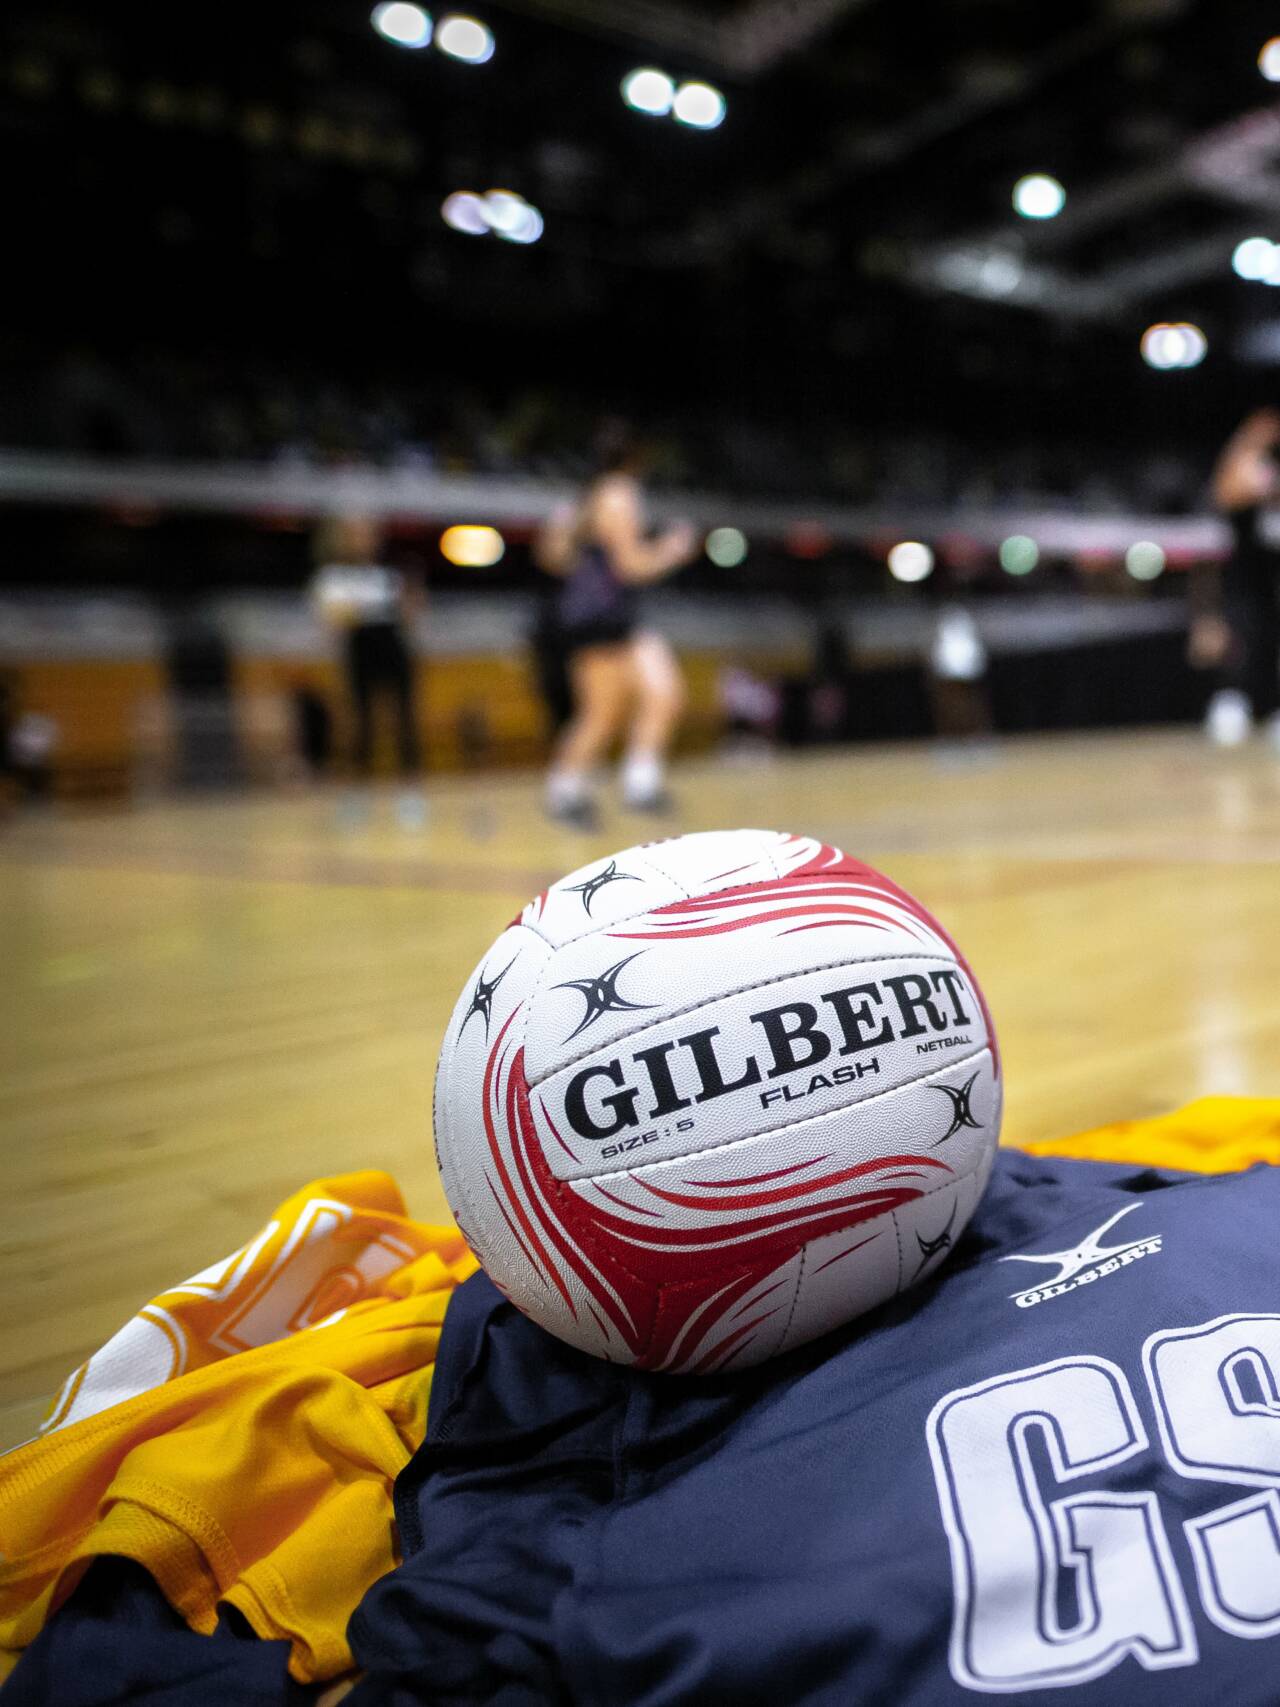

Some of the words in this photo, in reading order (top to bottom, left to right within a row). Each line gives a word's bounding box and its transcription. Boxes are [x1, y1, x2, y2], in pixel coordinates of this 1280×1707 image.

[564, 970, 971, 1140] GILBERT
[915, 1034, 973, 1055] NETBALL
[759, 1057, 881, 1109] FLASH
[601, 1129, 660, 1159] SIZE
[676, 1117, 695, 1133] 5
[1015, 1238, 1163, 1309] GILBERT
